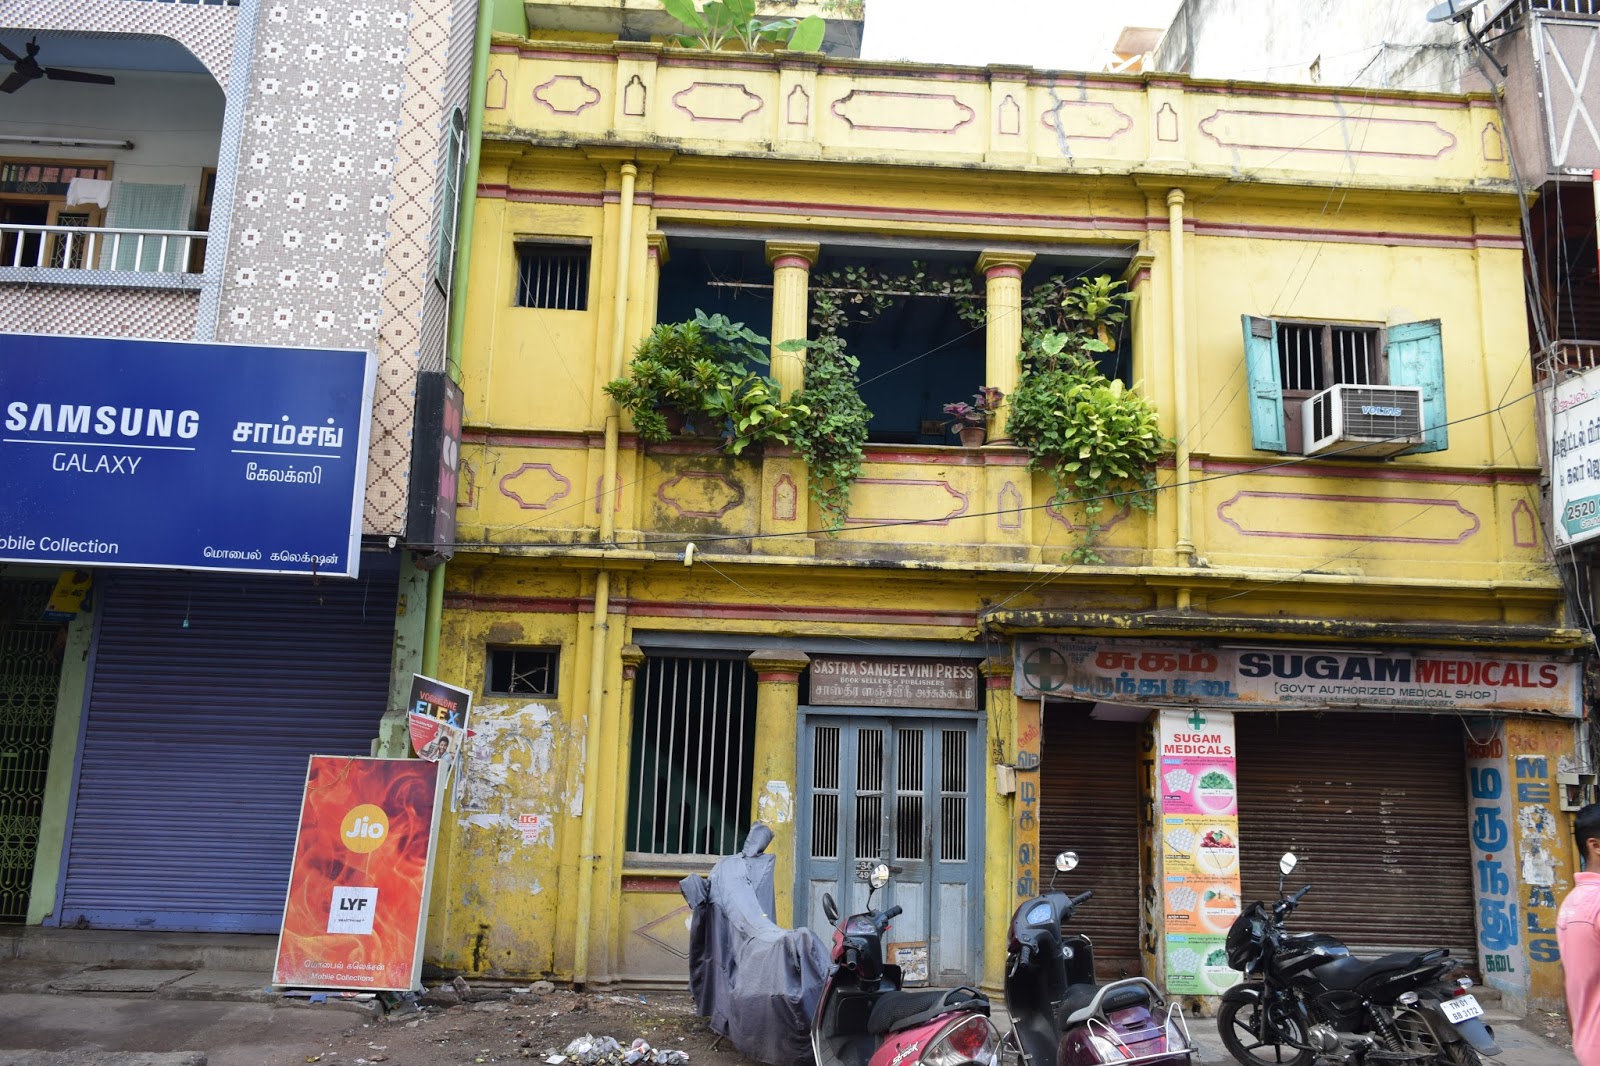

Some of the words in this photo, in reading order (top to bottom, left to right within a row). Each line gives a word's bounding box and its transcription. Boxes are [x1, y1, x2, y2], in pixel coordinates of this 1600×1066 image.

[1361, 405, 1402, 417] VOLTAS
[5, 401, 200, 439] SAMSUNG
[232, 415, 344, 448] சாம்சங்
[52, 452, 142, 475] GALAXY
[246, 461, 322, 484] கேலக்ஸி
[1567, 500, 1596, 521] 2520
[39, 536, 119, 554] Collection
[203, 546, 262, 561] மொபைல்
[1095, 646, 1219, 673] சுகம்
[814, 659, 857, 676] SASTRA
[859, 661, 933, 678] SANJEEVINI
[936, 664, 974, 680] PRESS
[1238, 653, 1411, 683] SUGAM
[1415, 659, 1559, 689] MEDICALS
[901, 679, 945, 687] PUBLISHERS
[1072, 672, 1167, 698] மருந்து
[1173, 679, 1239, 698] கடை
[1319, 685, 1396, 697] AUTHORIZED
[1400, 687, 1453, 699] MEDICAL
[1173, 733, 1222, 744] SUGAM
[1164, 744, 1231, 755] MEDICALS
[346, 816, 384, 838] Jio
[339, 898, 368, 911] LYF
[304, 960, 344, 969] மொபைல்
[1485, 954, 1515, 973] கடை
[310, 972, 335, 981] Mobile
[336, 973, 375, 982] Collections
[1113, 992, 1137, 1002] HONDA
[1449, 1002, 1460, 1010] TN
[1460, 999, 1468, 1007] 01
[1463, 1007, 1479, 1018] 3172
